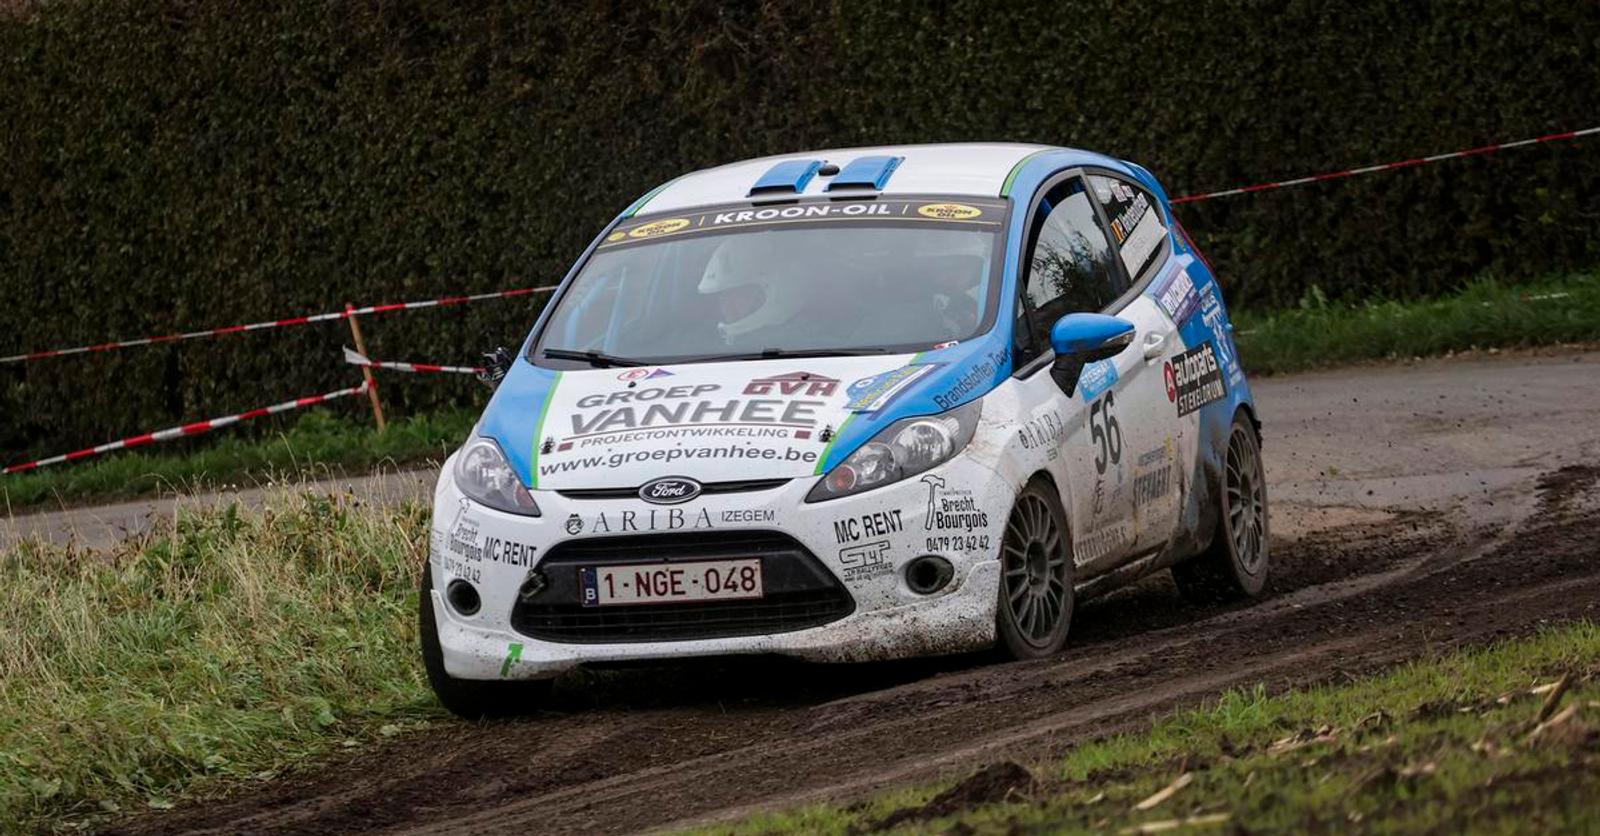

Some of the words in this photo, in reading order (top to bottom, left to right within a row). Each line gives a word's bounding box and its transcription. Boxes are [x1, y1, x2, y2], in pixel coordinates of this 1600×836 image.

[713, 204, 891, 226] KROON-OIL
[926, 206, 972, 215] KROON
[636, 221, 684, 235] KROON
[1175, 344, 1217, 387] autoparts
[575, 383, 722, 409] GROEP
[742, 381, 840, 397] GVH
[932, 361, 995, 411] Brandstoffen
[570, 398, 826, 436] VANHEE
[580, 426, 789, 449] PROJECTONTWIKKELING
[1090, 389, 1121, 475] 56
[540, 444, 818, 477] www.groepvanhee.be
[651, 481, 686, 498] Ford
[941, 497, 976, 512] Brecht
[592, 507, 715, 534] ARIBA
[721, 510, 775, 523] IZEGEM
[834, 518, 860, 544] MC
[862, 509, 904, 538] RENT
[936, 511, 989, 533] Bourgois
[483, 536, 501, 562] MC
[502, 541, 537, 568] RENT
[926, 537, 949, 552] 0479
[952, 536, 964, 551] 23
[965, 535, 977, 550] 42
[979, 534, 990, 550] 42
[585, 588, 596, 600] B
